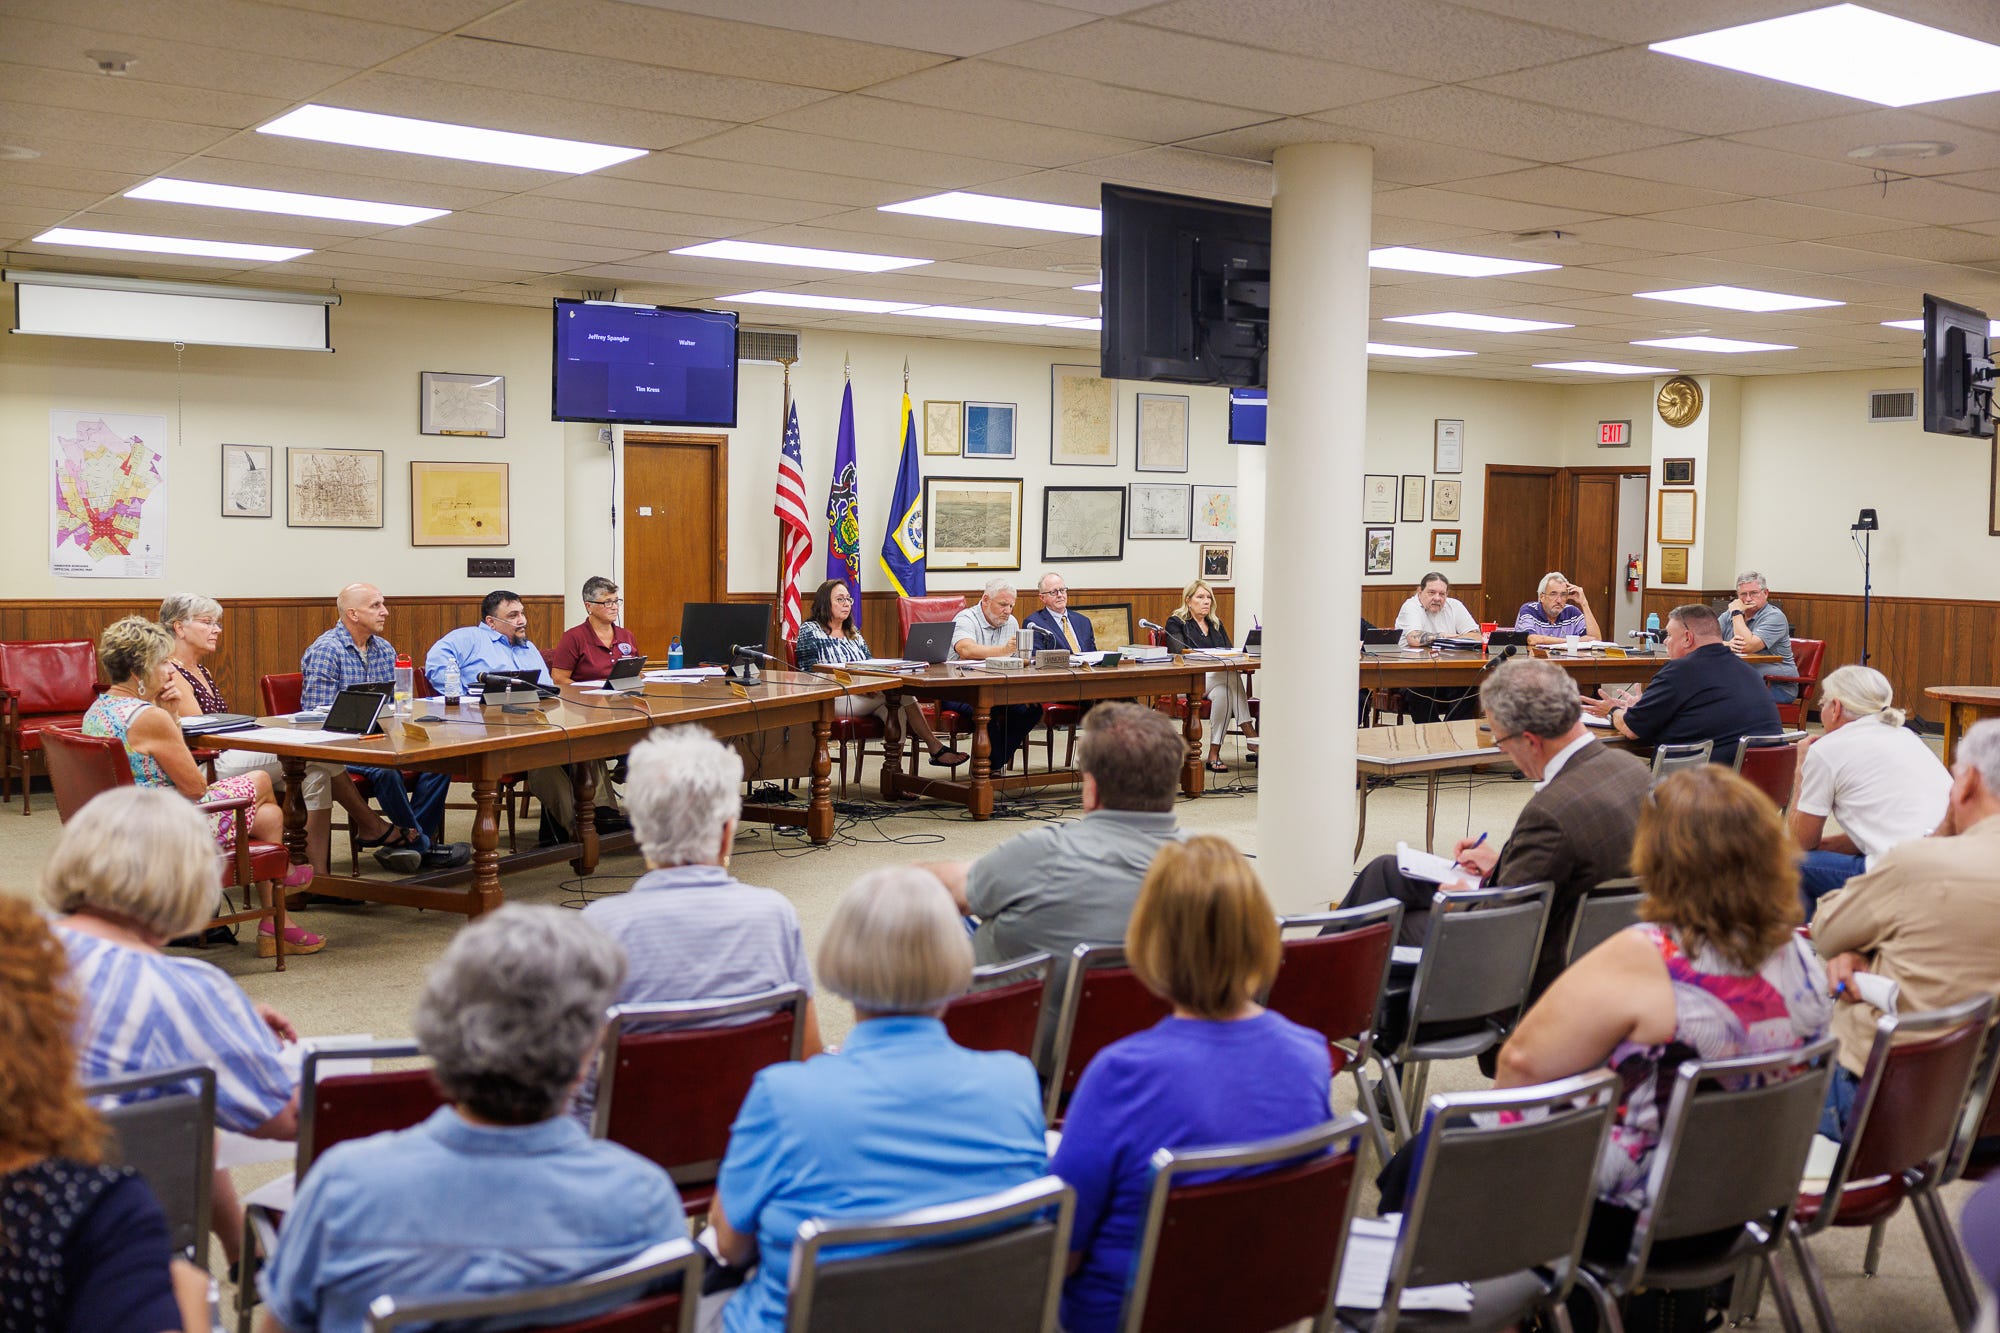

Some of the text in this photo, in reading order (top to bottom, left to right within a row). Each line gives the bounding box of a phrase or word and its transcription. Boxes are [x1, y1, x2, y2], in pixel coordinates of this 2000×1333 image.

[588, 334, 630, 343] Jeffrey Spangler
[1601, 424, 1622, 443] EXIT
